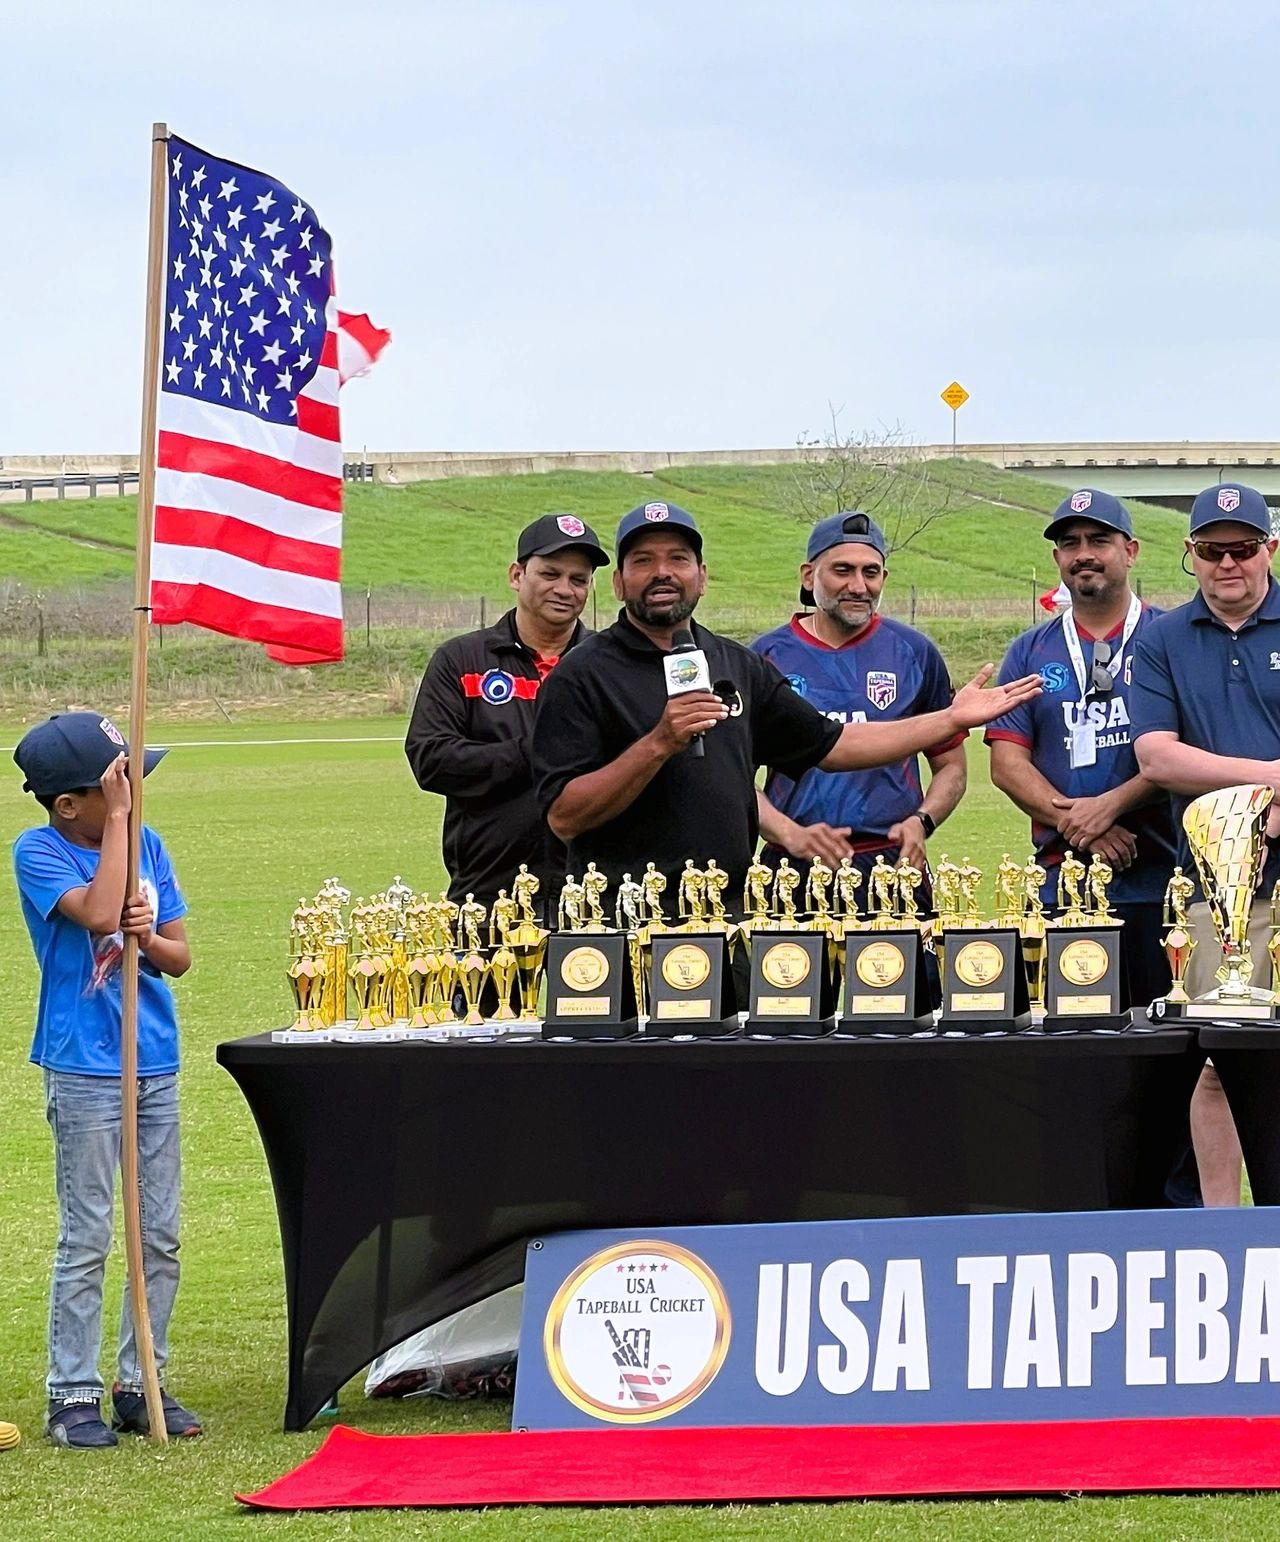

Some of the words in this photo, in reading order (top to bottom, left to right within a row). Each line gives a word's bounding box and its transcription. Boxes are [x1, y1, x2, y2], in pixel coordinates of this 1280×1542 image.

[1062, 696, 1130, 731] USA
[1064, 732, 1131, 750] TBALL
[626, 1278, 656, 1294] USA
[577, 1298, 642, 1314] TAPEBALL
[650, 1297, 705, 1313] CRICKET
[755, 1258, 930, 1396] USA
